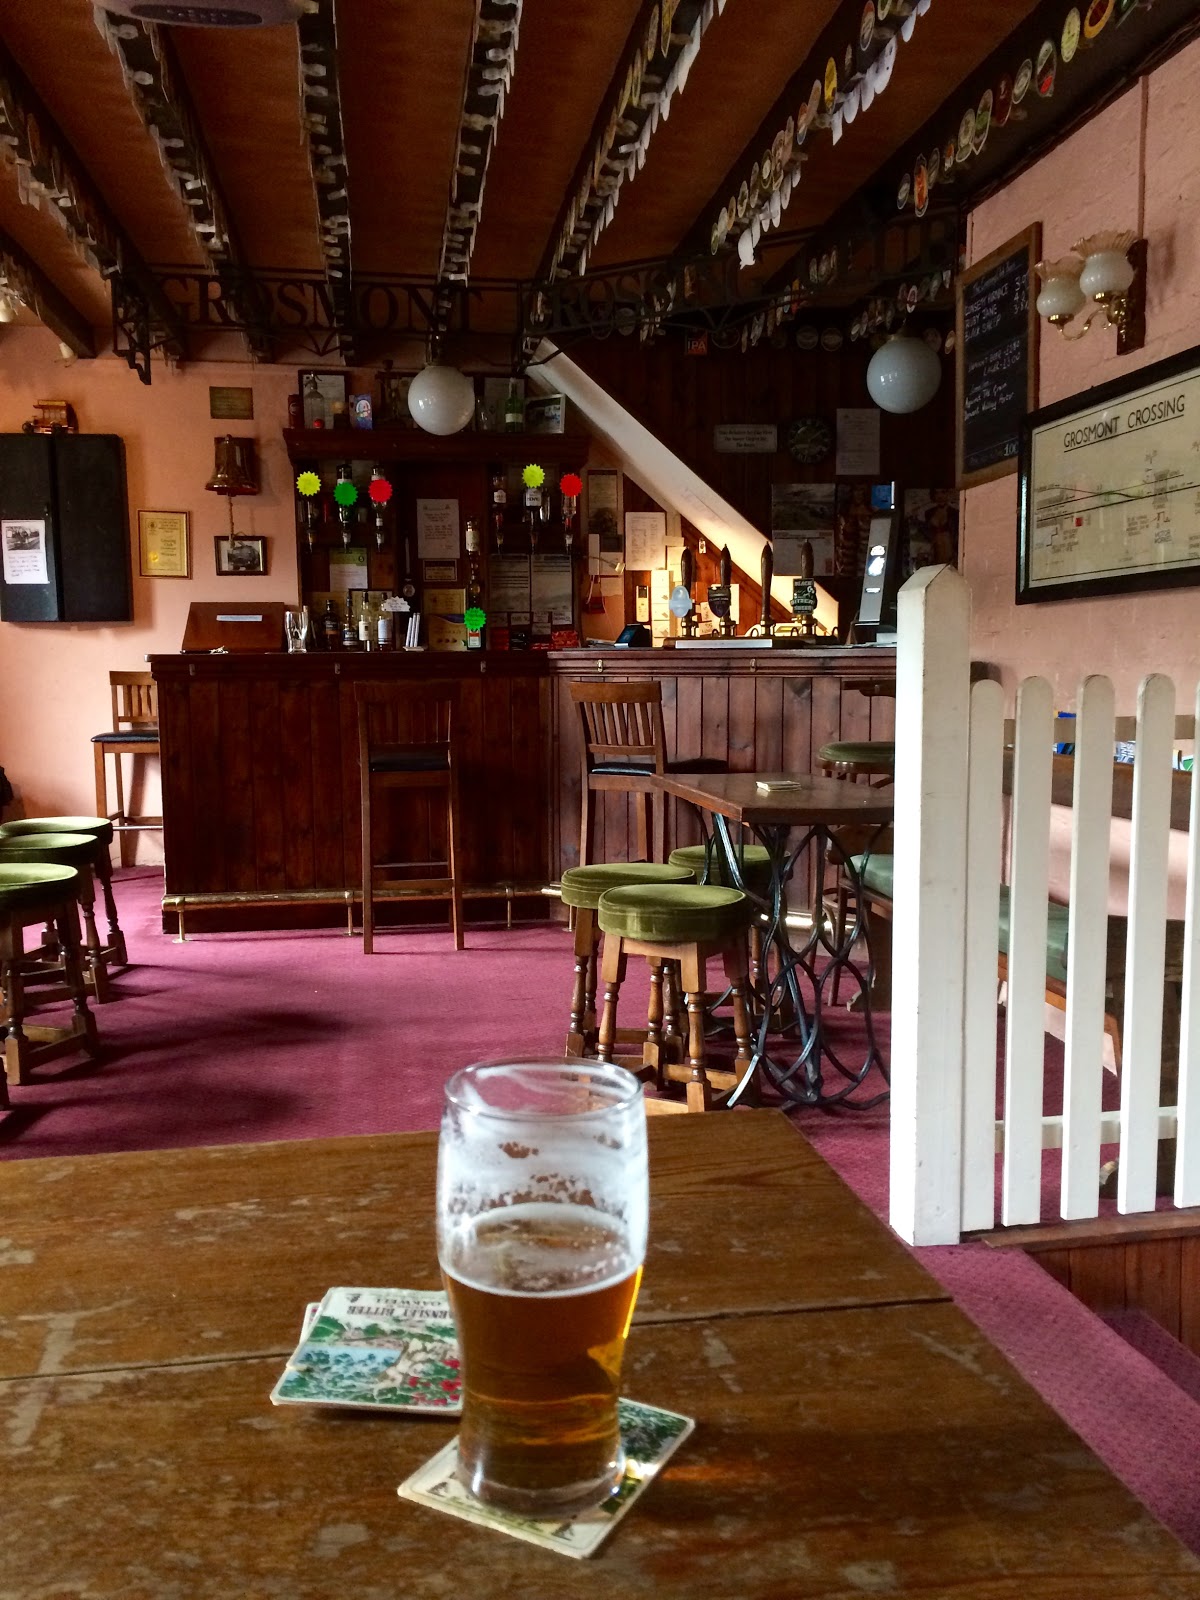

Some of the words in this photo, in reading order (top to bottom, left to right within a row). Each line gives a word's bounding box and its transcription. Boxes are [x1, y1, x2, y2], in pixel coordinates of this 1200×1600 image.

[687, 340, 706, 350] IPA
[1063, 415, 1120, 448] GROSMONT
[1127, 394, 1186, 429] CROSSING
[346, 1305, 395, 1317] BITTER
[403, 1308, 453, 1320] ARNSLEY
